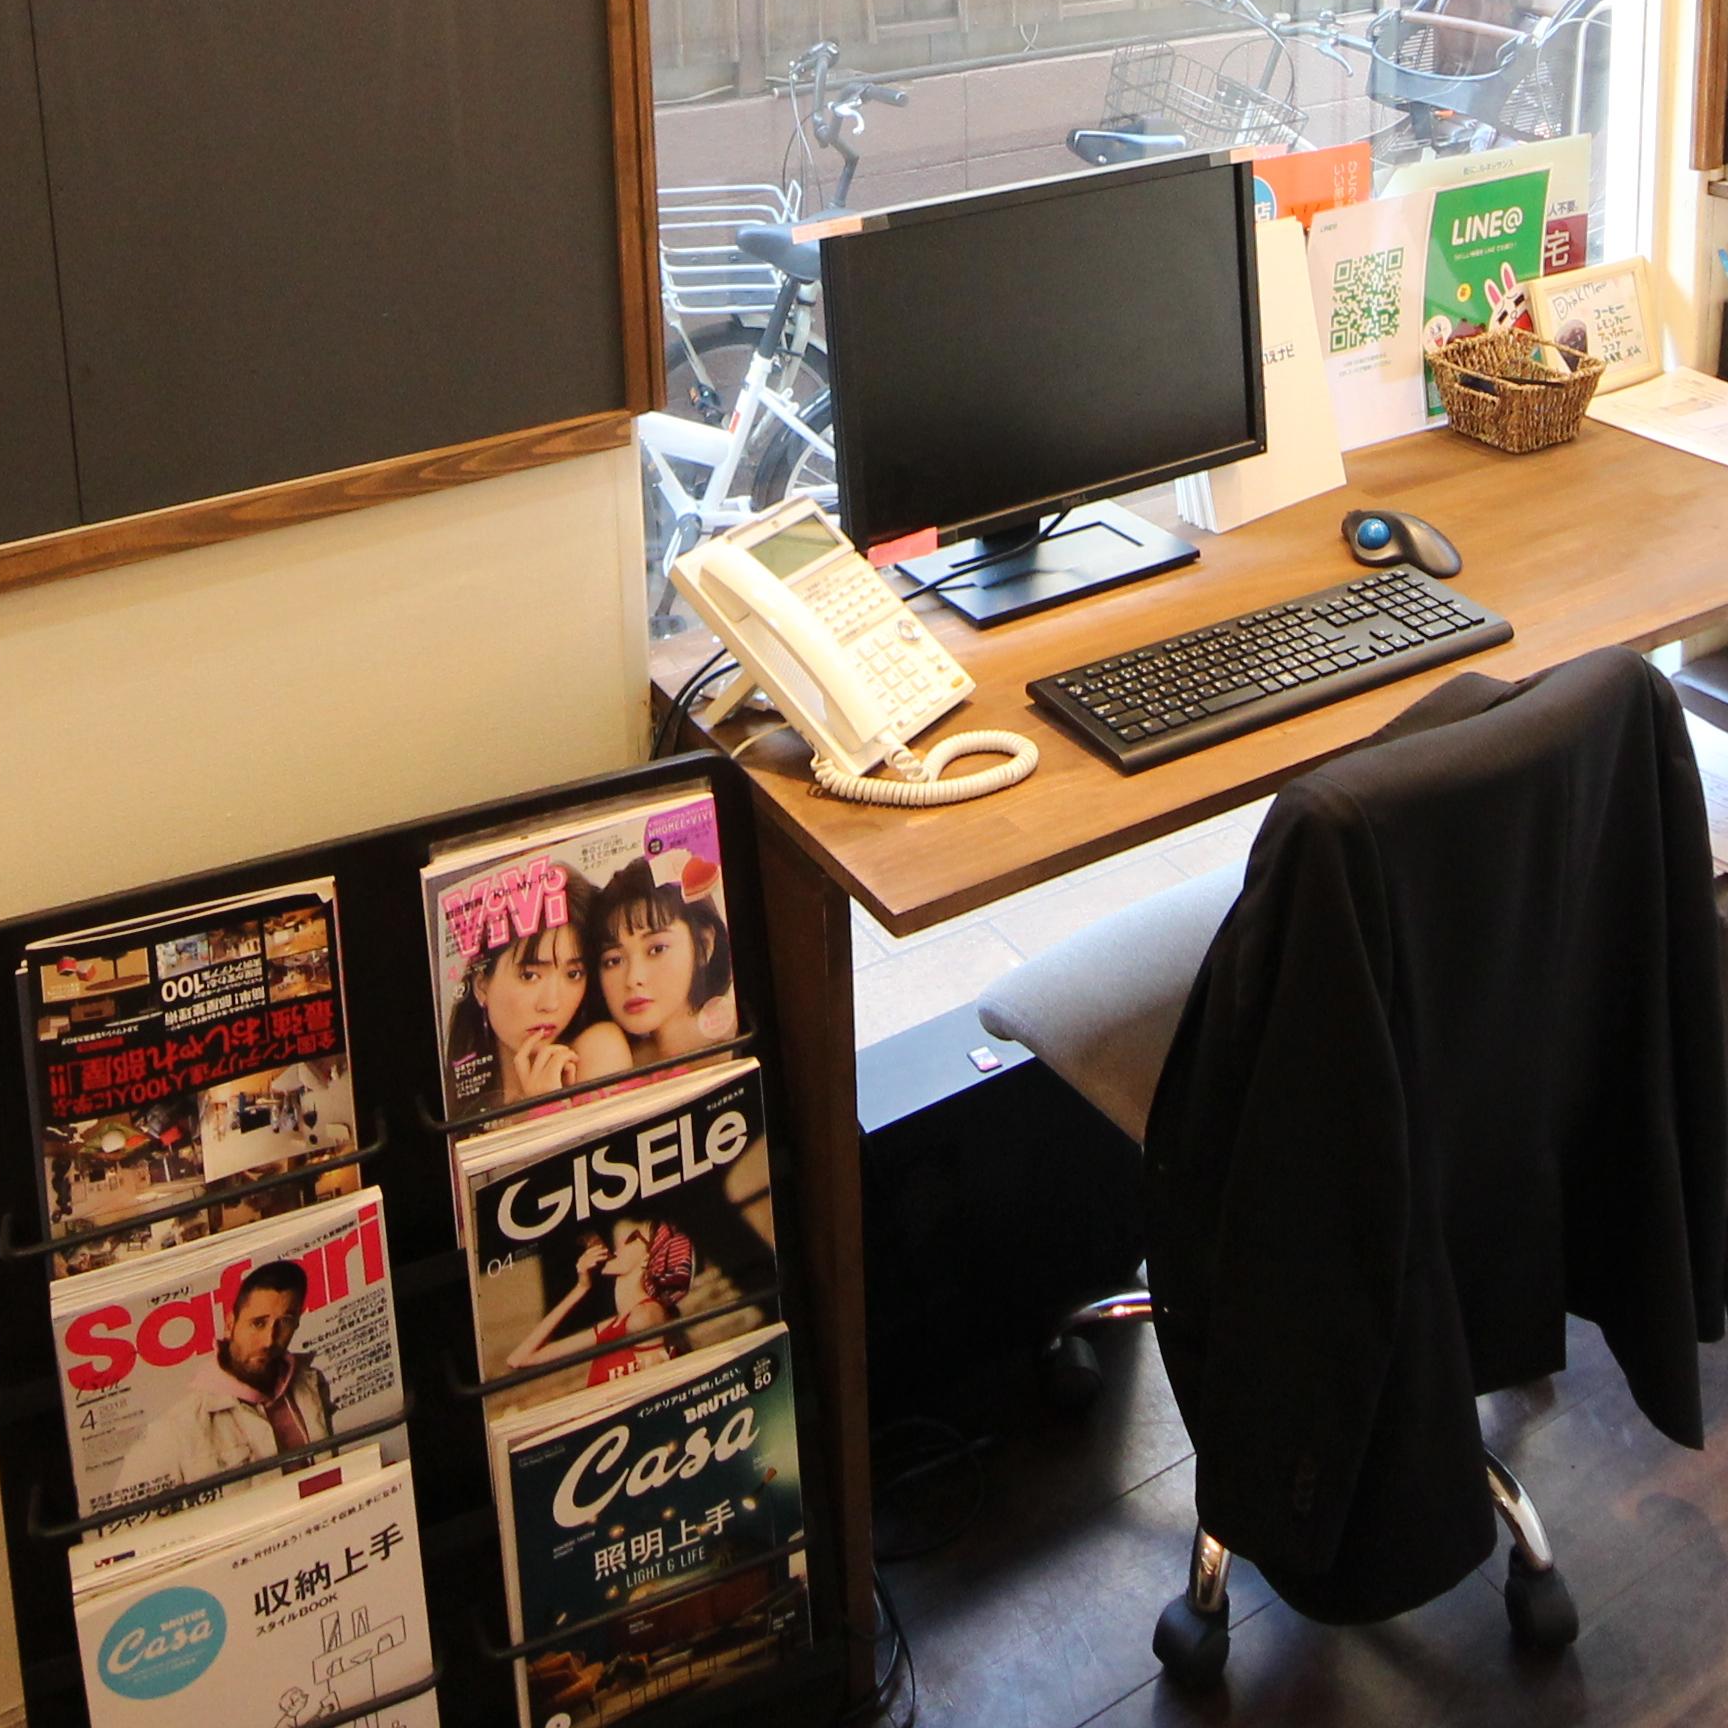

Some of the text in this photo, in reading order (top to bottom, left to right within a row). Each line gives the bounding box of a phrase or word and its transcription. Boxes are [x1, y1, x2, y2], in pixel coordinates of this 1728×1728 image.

[1450, 205, 1524, 247] LINE@
[442, 854, 569, 960] ViVi
[161, 973, 206, 1003] 100
[497, 1110, 749, 1242] GISELe
[486, 1252, 514, 1279] 04
[64, 1202, 385, 1391] Safari
[753, 1371, 773, 1390] 50
[79, 1408, 98, 1431] 4
[552, 1407, 761, 1529] Casa
[593, 1498, 736, 1581] 照明上手
[253, 1522, 405, 1619] 収納上手
[625, 1566, 662, 1589] LIGHT
[680, 1545, 707, 1569] LIFE
[255, 1592, 340, 1638] スタイルBOOK
[106, 1619, 215, 1675] Casa
